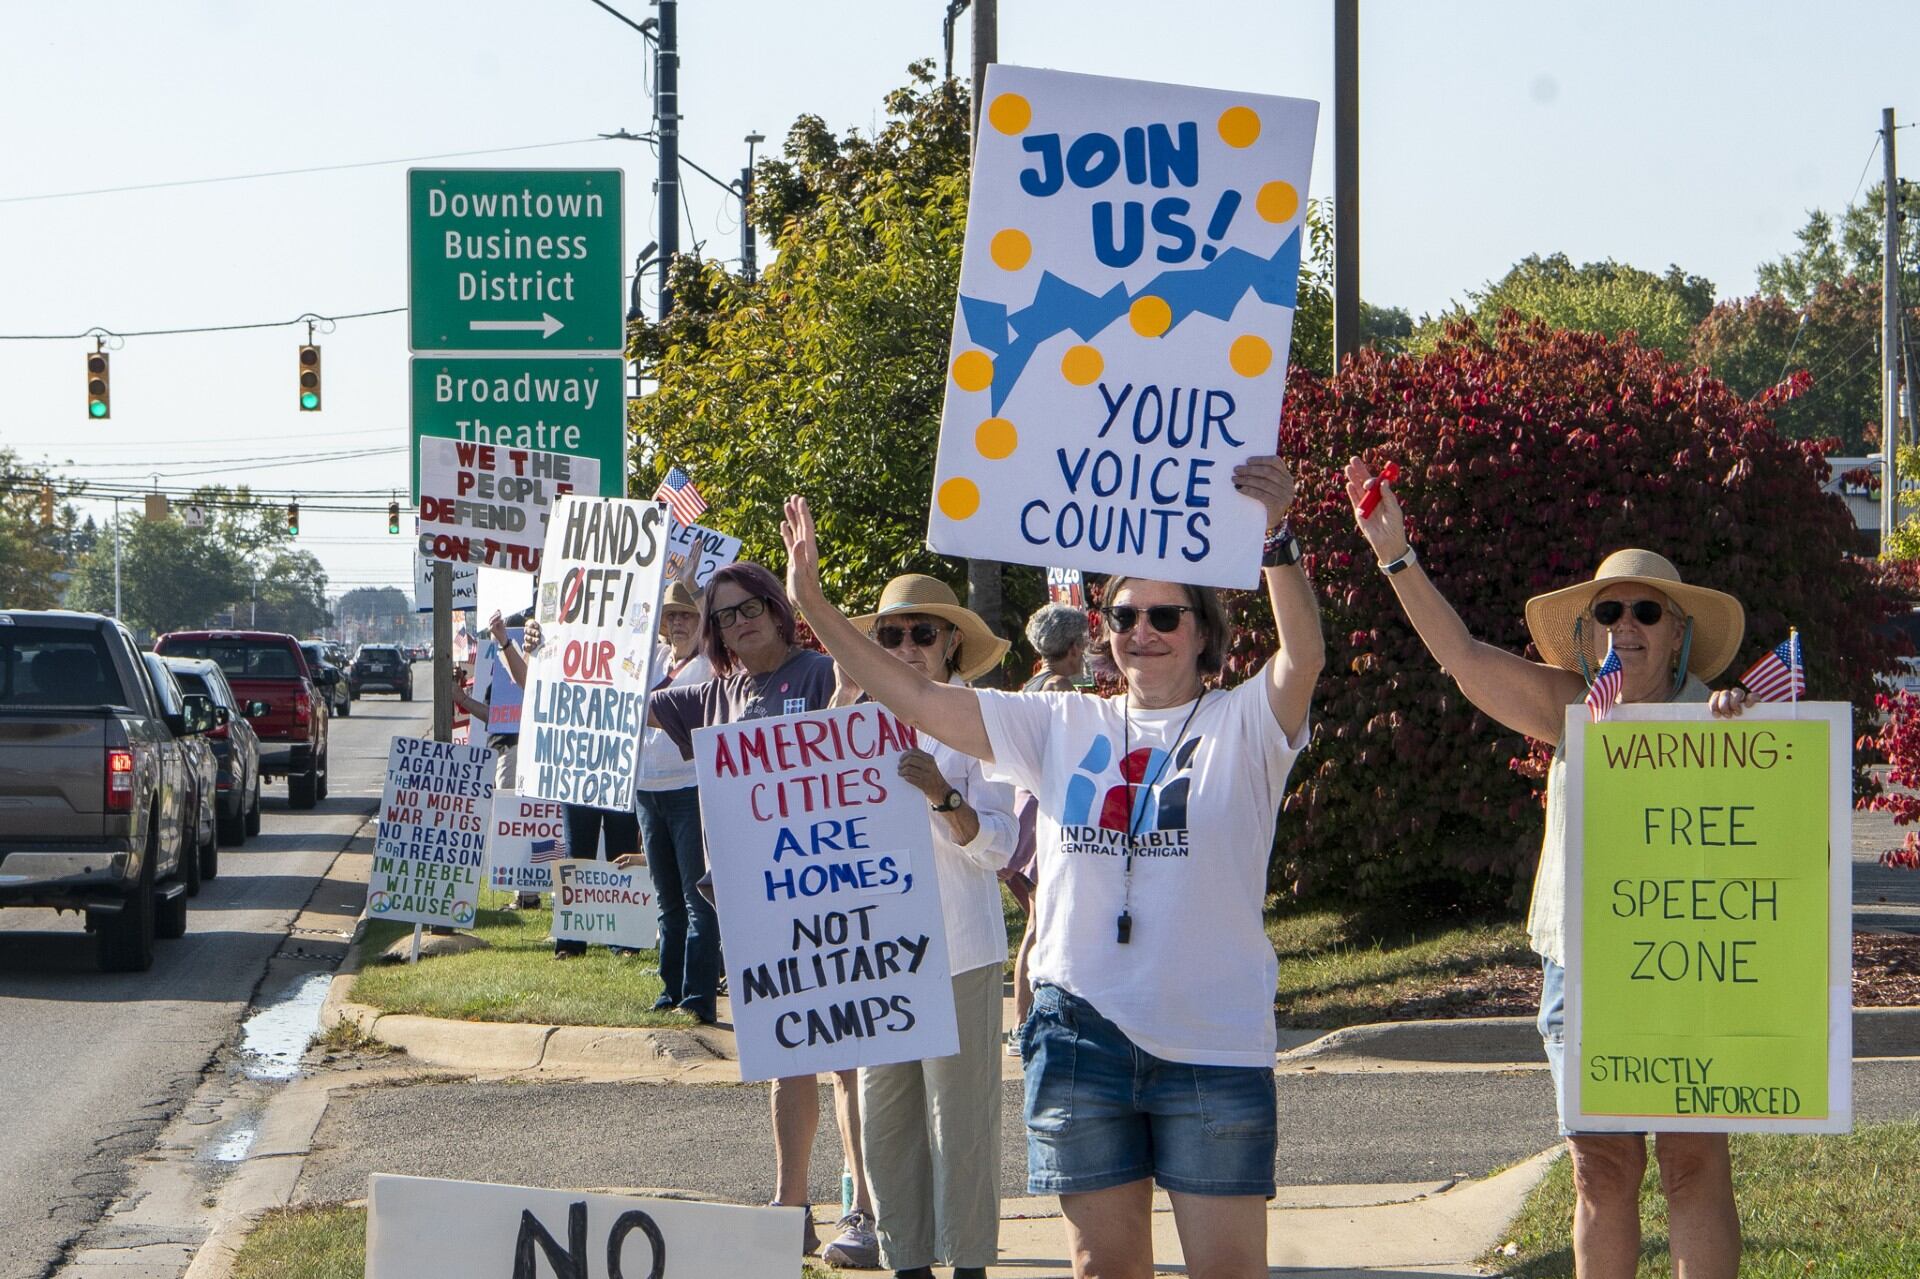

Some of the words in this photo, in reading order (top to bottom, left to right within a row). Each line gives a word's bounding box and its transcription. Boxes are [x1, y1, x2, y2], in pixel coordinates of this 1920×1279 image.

[1019, 121, 1200, 198] JOIN
[428, 188, 604, 218] Downtown
[445, 228, 588, 260] Business
[1092, 189, 1242, 268] US!
[459, 270, 575, 301] District
[435, 373, 600, 410] Broadway
[455, 420, 581, 449] Theatre
[1097, 382, 1246, 449] YOUR
[455, 442, 496, 471] WE
[509, 450, 571, 481] THE
[1057, 447, 1216, 508] VOICE
[420, 495, 527, 533] DEFEND
[1020, 499, 1212, 563] COUNTS
[418, 532, 544, 573] CONSTITU
[562, 500, 661, 568] HANDS
[671, 521, 725, 558] LENOL
[559, 567, 634, 627] OFF!
[563, 640, 616, 680] OUR
[534, 680, 643, 737] LIBRARIES
[396, 738, 456, 761] SPEAK
[469, 747, 492, 765] UP
[534, 726, 634, 777] MUSEUMS
[714, 708, 918, 778] AMERICAN
[1602, 731, 1794, 769] WARNING:
[388, 769, 409, 790] THE
[409, 774, 494, 800] MADNESS
[399, 756, 483, 781] AGAINST
[538, 765, 632, 809] HISTORY!
[395, 790, 419, 807] NO
[427, 793, 476, 815] MORE
[751, 767, 888, 822] CITIES
[378, 822, 402, 840] NO
[412, 826, 485, 850] REASON
[387, 806, 423, 825] WAR
[434, 811, 482, 832] PIGS
[1060, 826, 1189, 847] INDIVISIBLE
[1645, 806, 1758, 846] FREE
[377, 839, 400, 857] FOR
[399, 842, 482, 867] TREASON
[773, 816, 871, 863] ARE
[1060, 843, 1118, 856] CENTRAL
[1122, 847, 1189, 857] MICHIGAN
[386, 875, 436, 897] WITH
[443, 882, 455, 899] A
[397, 859, 409, 876] A
[415, 861, 475, 885] REBEL
[559, 864, 632, 888] FREEDOM
[764, 856, 913, 901] HOMES,
[391, 894, 452, 916] CAUSE
[562, 885, 651, 906] DEMOCRACY
[1612, 879, 1778, 921] SPEECH
[560, 910, 616, 931] TRUTH
[792, 905, 880, 951] NOT
[742, 934, 930, 1005] MILITARY
[1630, 940, 1759, 983] ZONE
[774, 995, 916, 1049] CAMPS
[1590, 1054, 1715, 1085] STRICTLY
[1675, 1085, 1801, 1115] ENFORCED
[512, 1200, 667, 1279] NO
